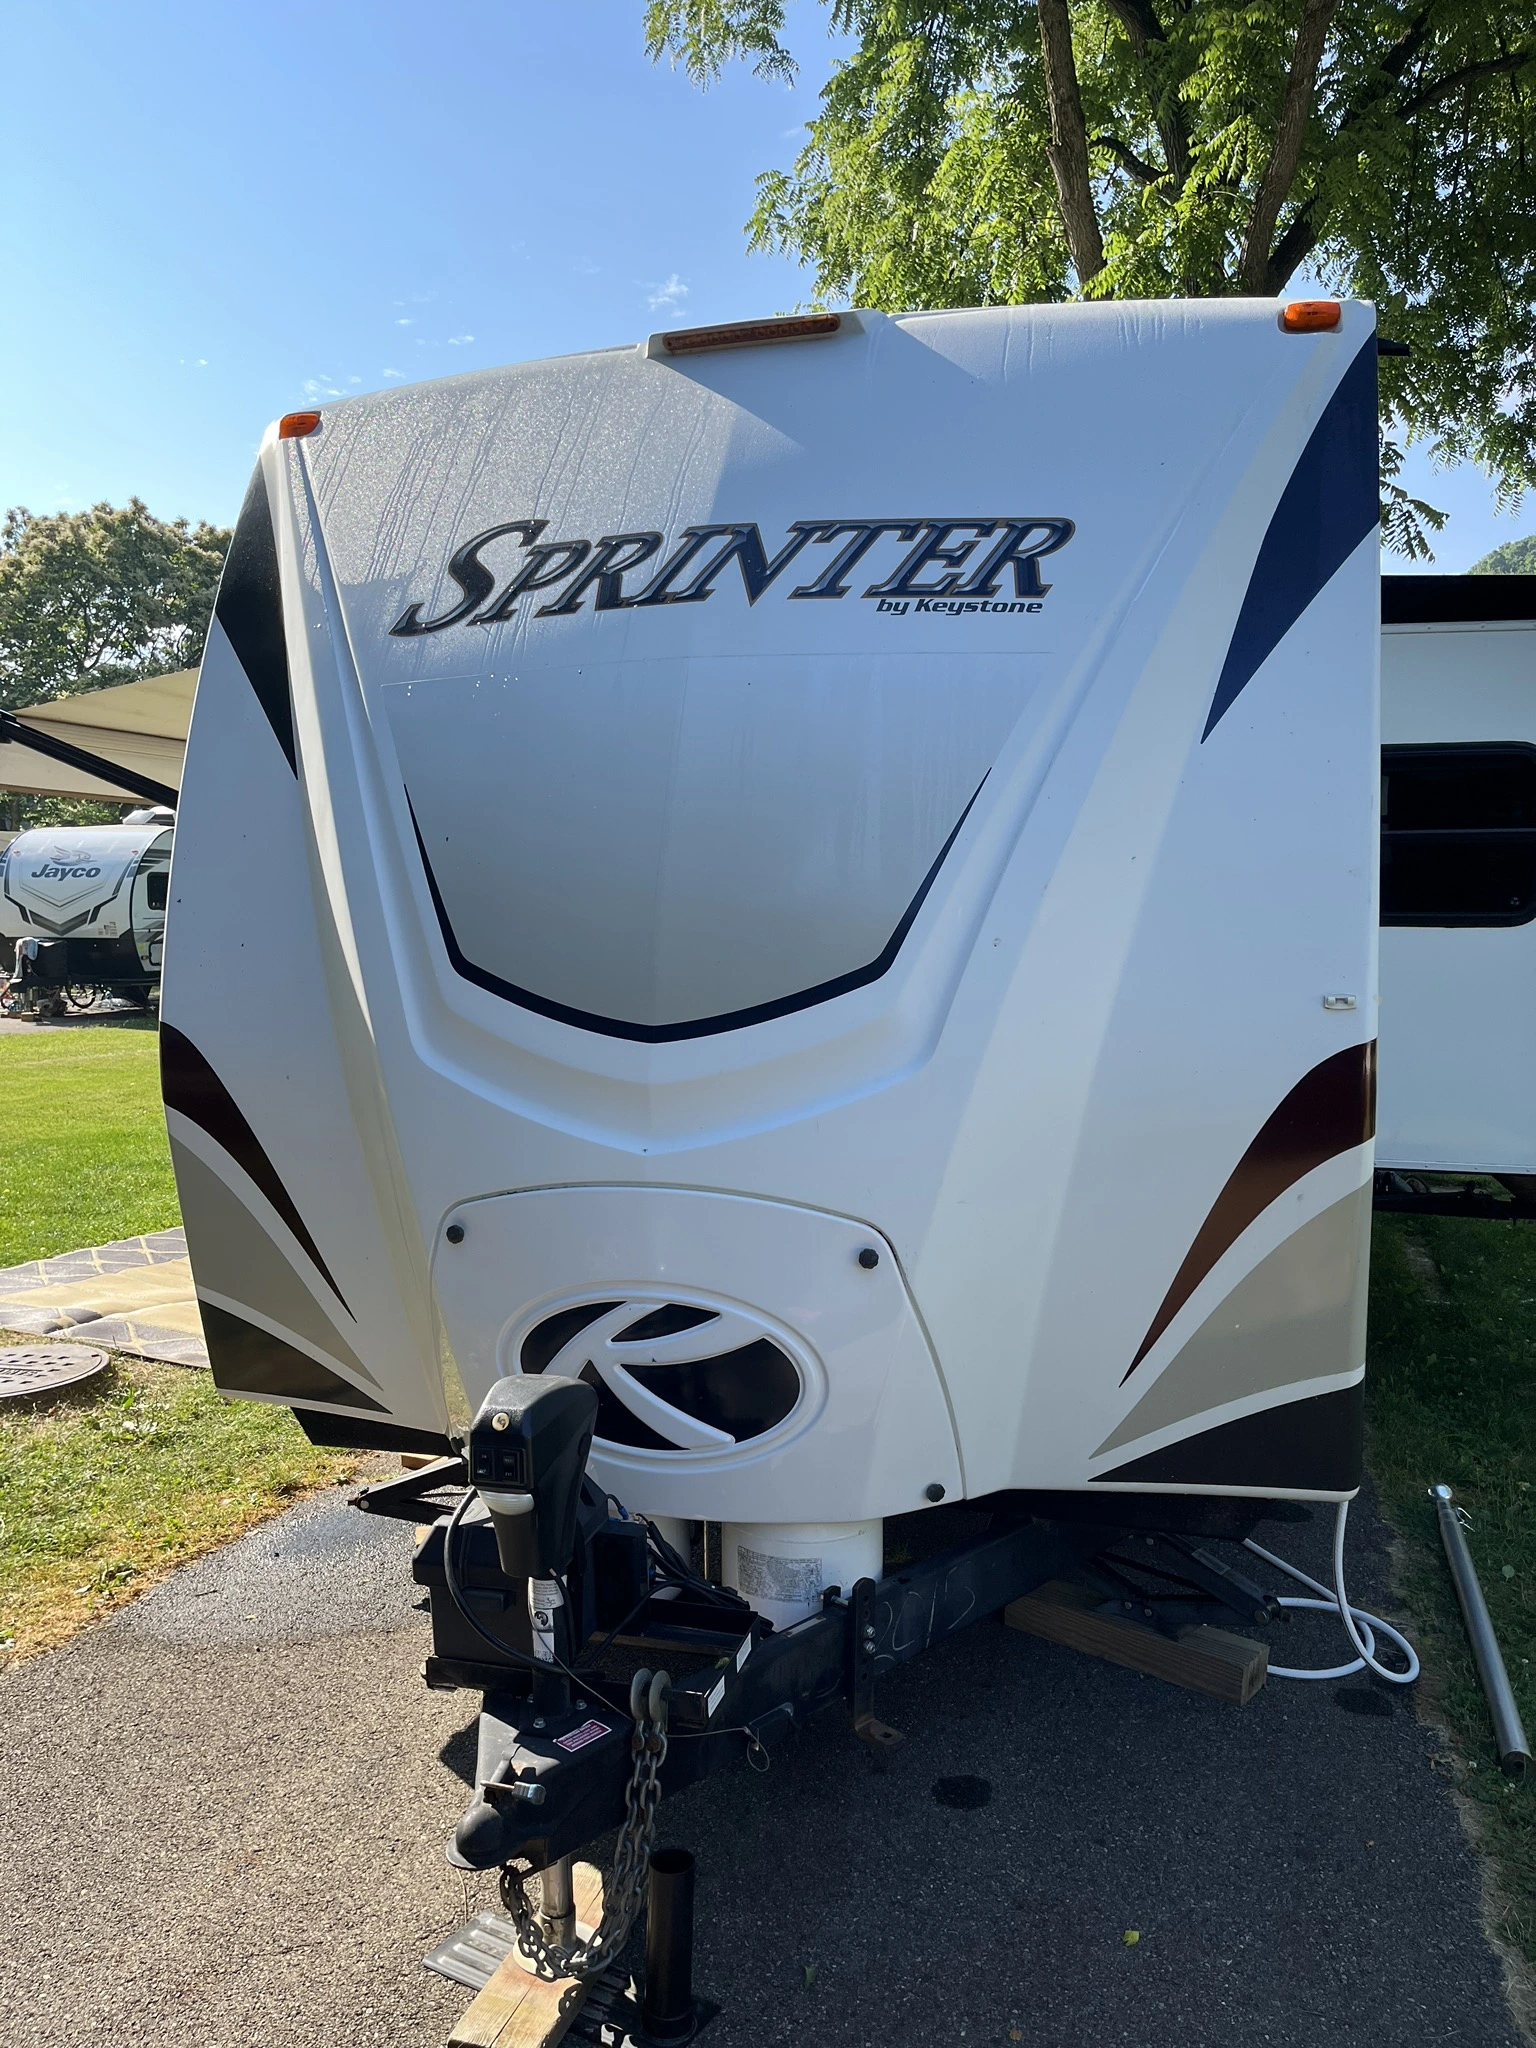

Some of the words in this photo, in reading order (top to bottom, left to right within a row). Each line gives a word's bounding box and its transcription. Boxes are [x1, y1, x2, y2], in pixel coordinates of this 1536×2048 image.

[388, 517, 1076, 637] SPRINTER
[876, 599, 910, 615] by
[914, 599, 1043, 616] Keystone
[31, 863, 101, 881] Jayco
